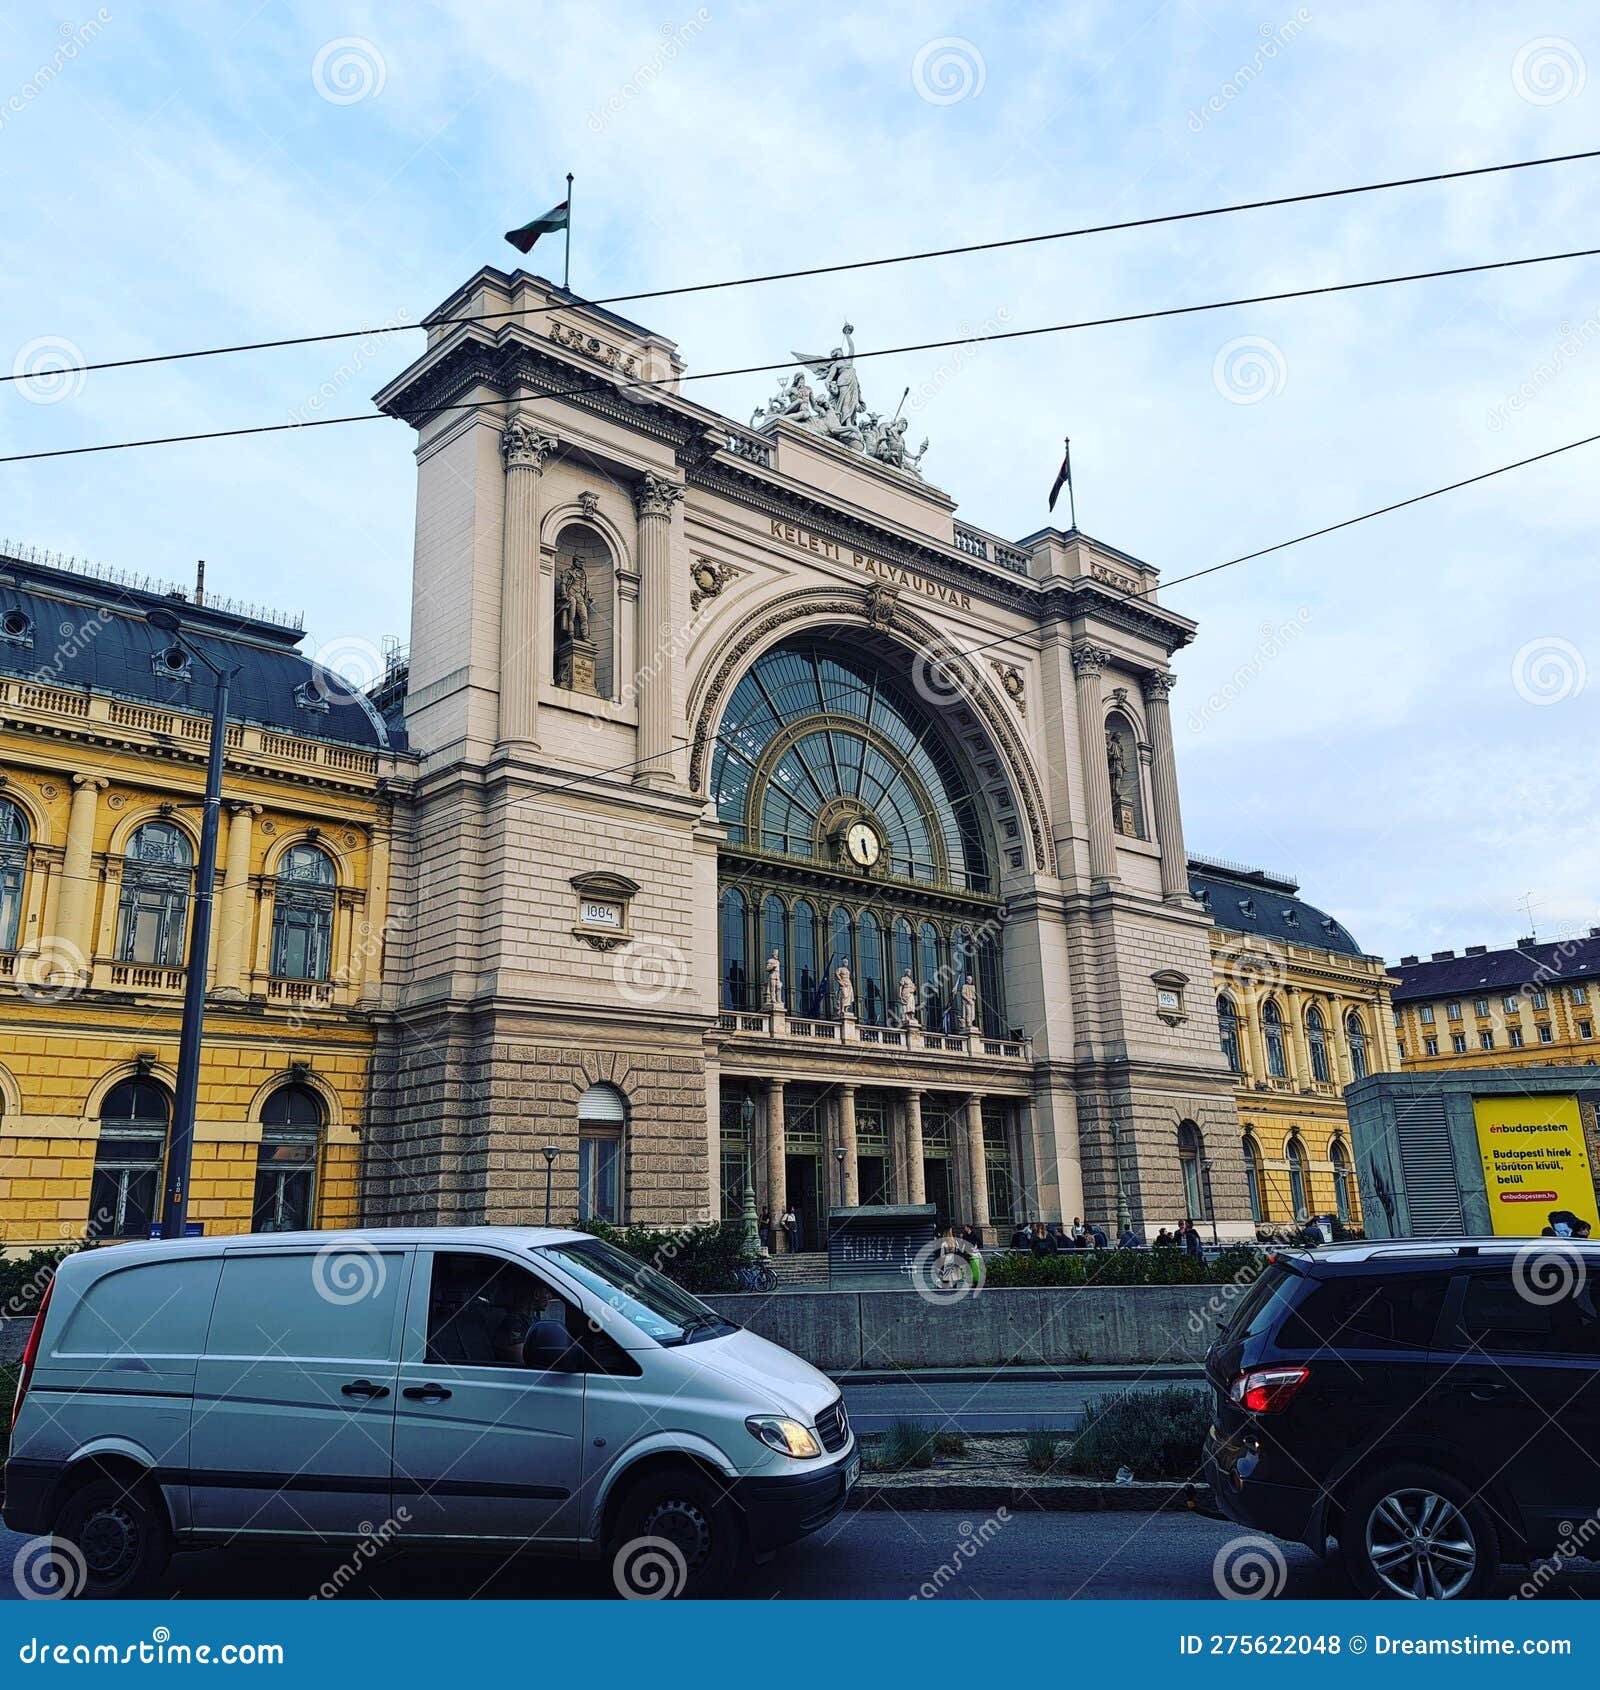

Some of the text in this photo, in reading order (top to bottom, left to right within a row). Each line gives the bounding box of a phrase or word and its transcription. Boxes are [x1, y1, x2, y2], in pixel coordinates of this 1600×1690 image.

[770, 520, 840, 560] KELETI
[1490, 1123, 1568, 1134] énbudapestem
[1493, 1147, 1571, 1160] Budapesti hírek
[1495, 1161, 1533, 1171] körúton
[1497, 1174, 1523, 1184] belül
